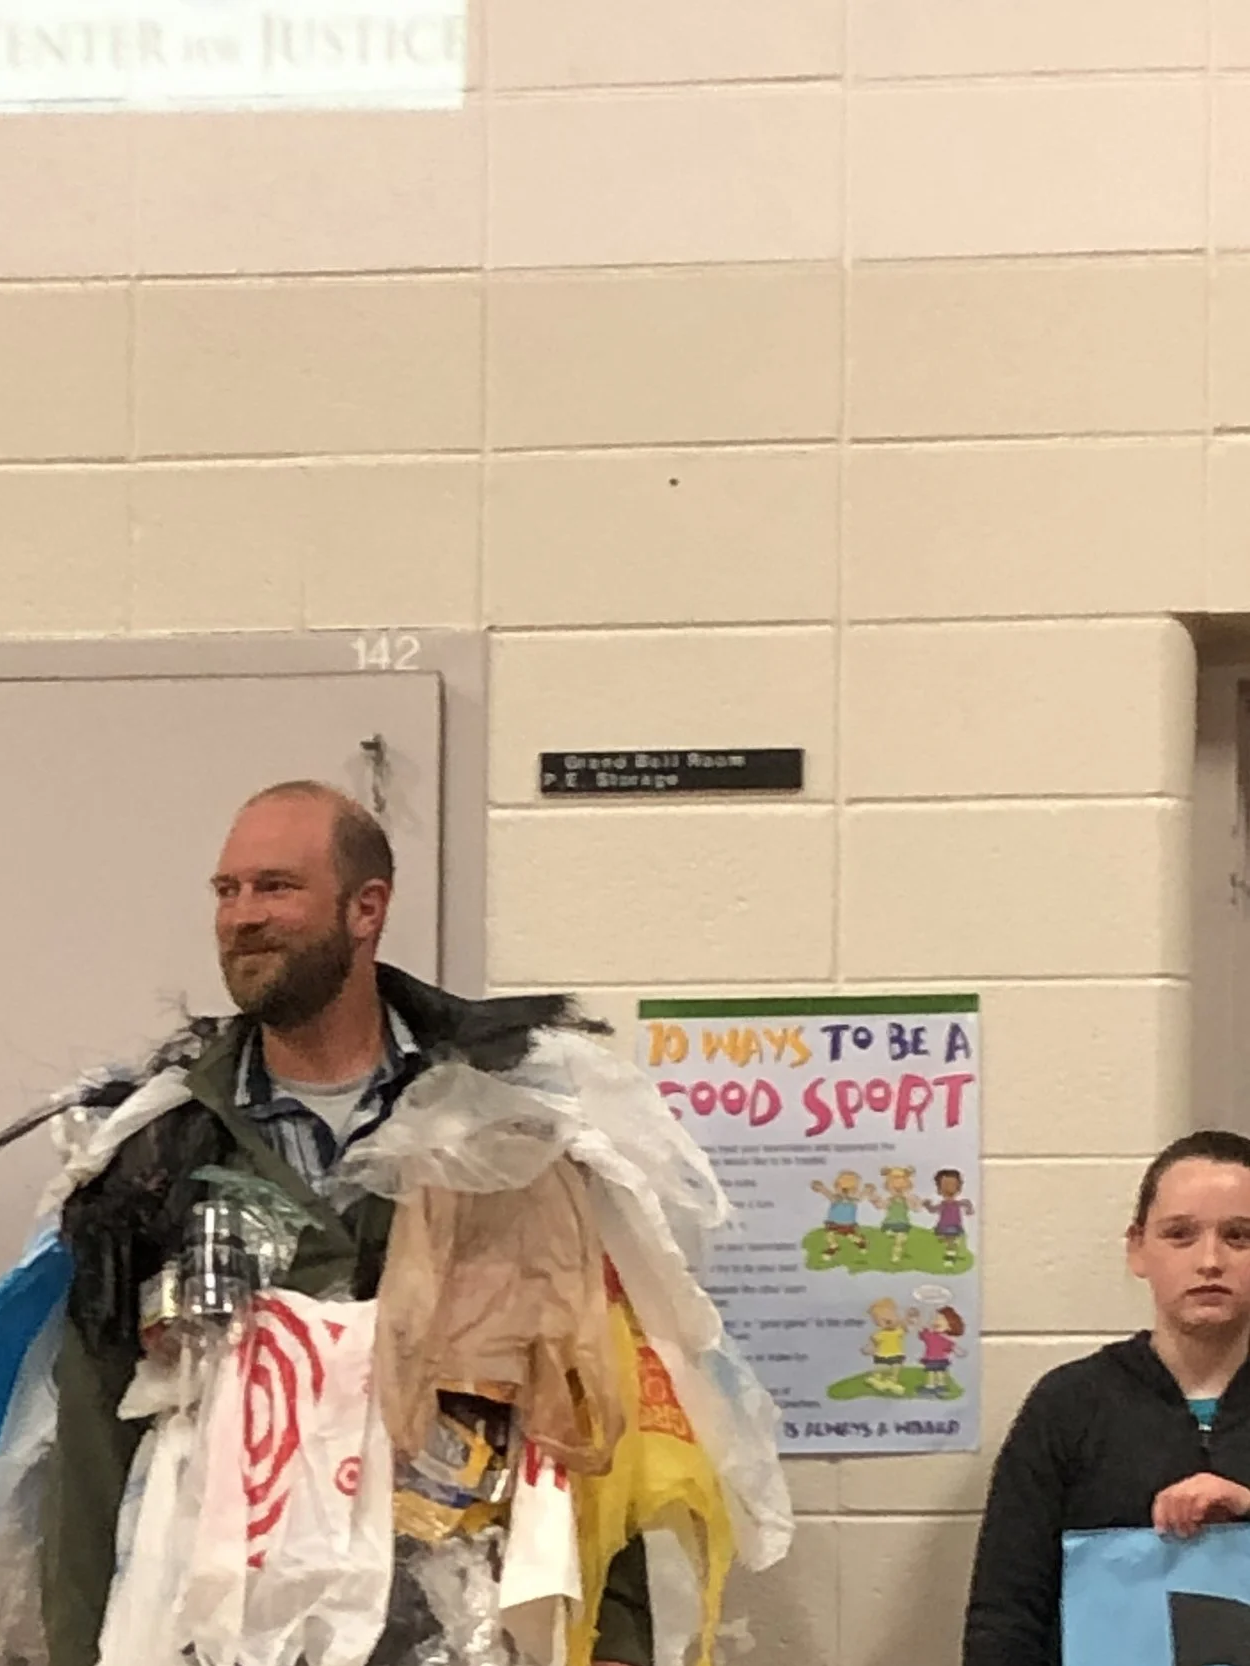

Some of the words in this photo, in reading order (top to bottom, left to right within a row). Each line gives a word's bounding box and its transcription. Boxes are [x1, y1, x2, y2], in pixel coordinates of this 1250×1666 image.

[351, 635, 421, 670] 142
[646, 1023, 690, 1067] 10
[702, 1024, 813, 1068] WAYS
[820, 1024, 875, 1062] TO
[887, 1021, 931, 1061] BE
[944, 1022, 973, 1063] A
[801, 1072, 976, 1138] SPORT
